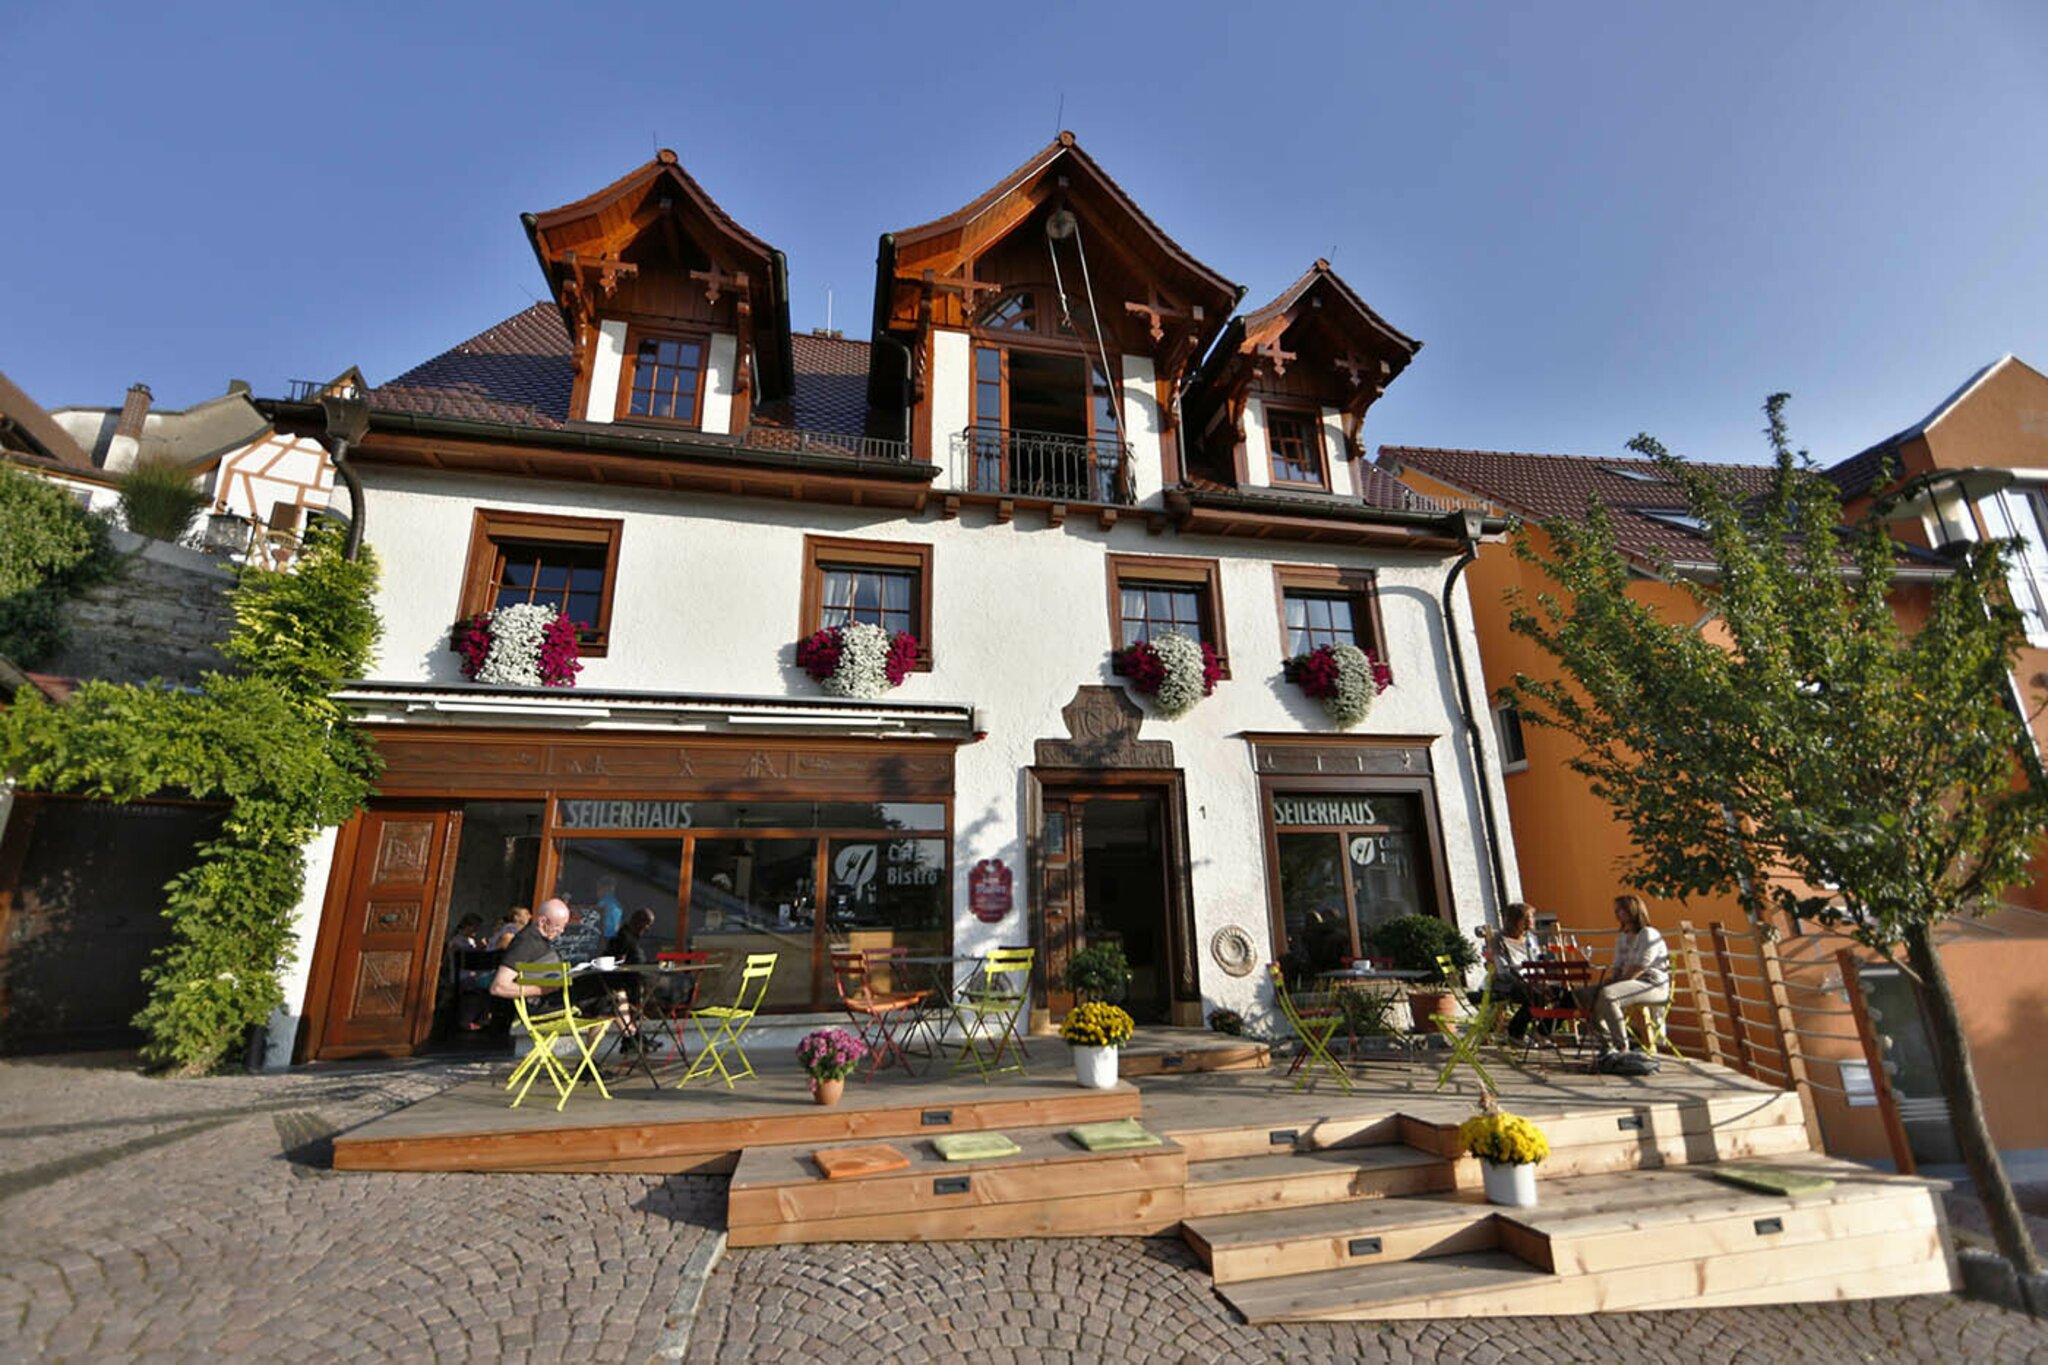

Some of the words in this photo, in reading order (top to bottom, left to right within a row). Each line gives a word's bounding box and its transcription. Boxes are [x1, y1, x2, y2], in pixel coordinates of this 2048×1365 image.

[566, 801, 694, 829] SEILERHAUS
[1273, 799, 1377, 825] SEILERHAUS
[886, 866, 938, 886] Bistro
